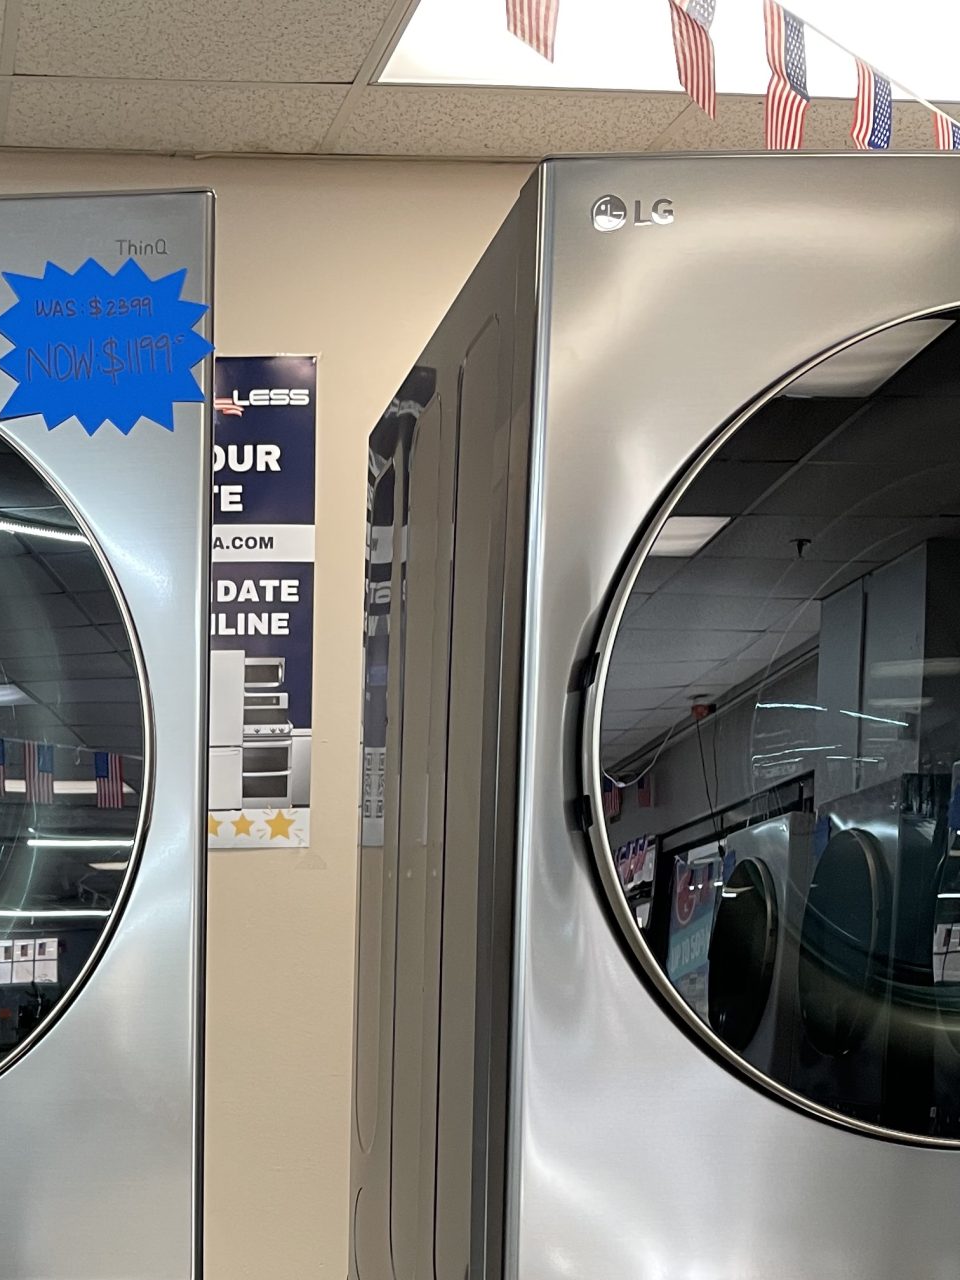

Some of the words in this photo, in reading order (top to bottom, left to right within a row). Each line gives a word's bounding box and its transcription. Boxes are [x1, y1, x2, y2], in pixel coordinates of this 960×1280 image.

[633, 198, 675, 226] LG
[115, 238, 168, 256] ThinQ
[232, 388, 310, 406] LESS
[213, 536, 274, 550] A.COM
[216, 579, 300, 602] DATE
[211, 612, 290, 636] LINE
